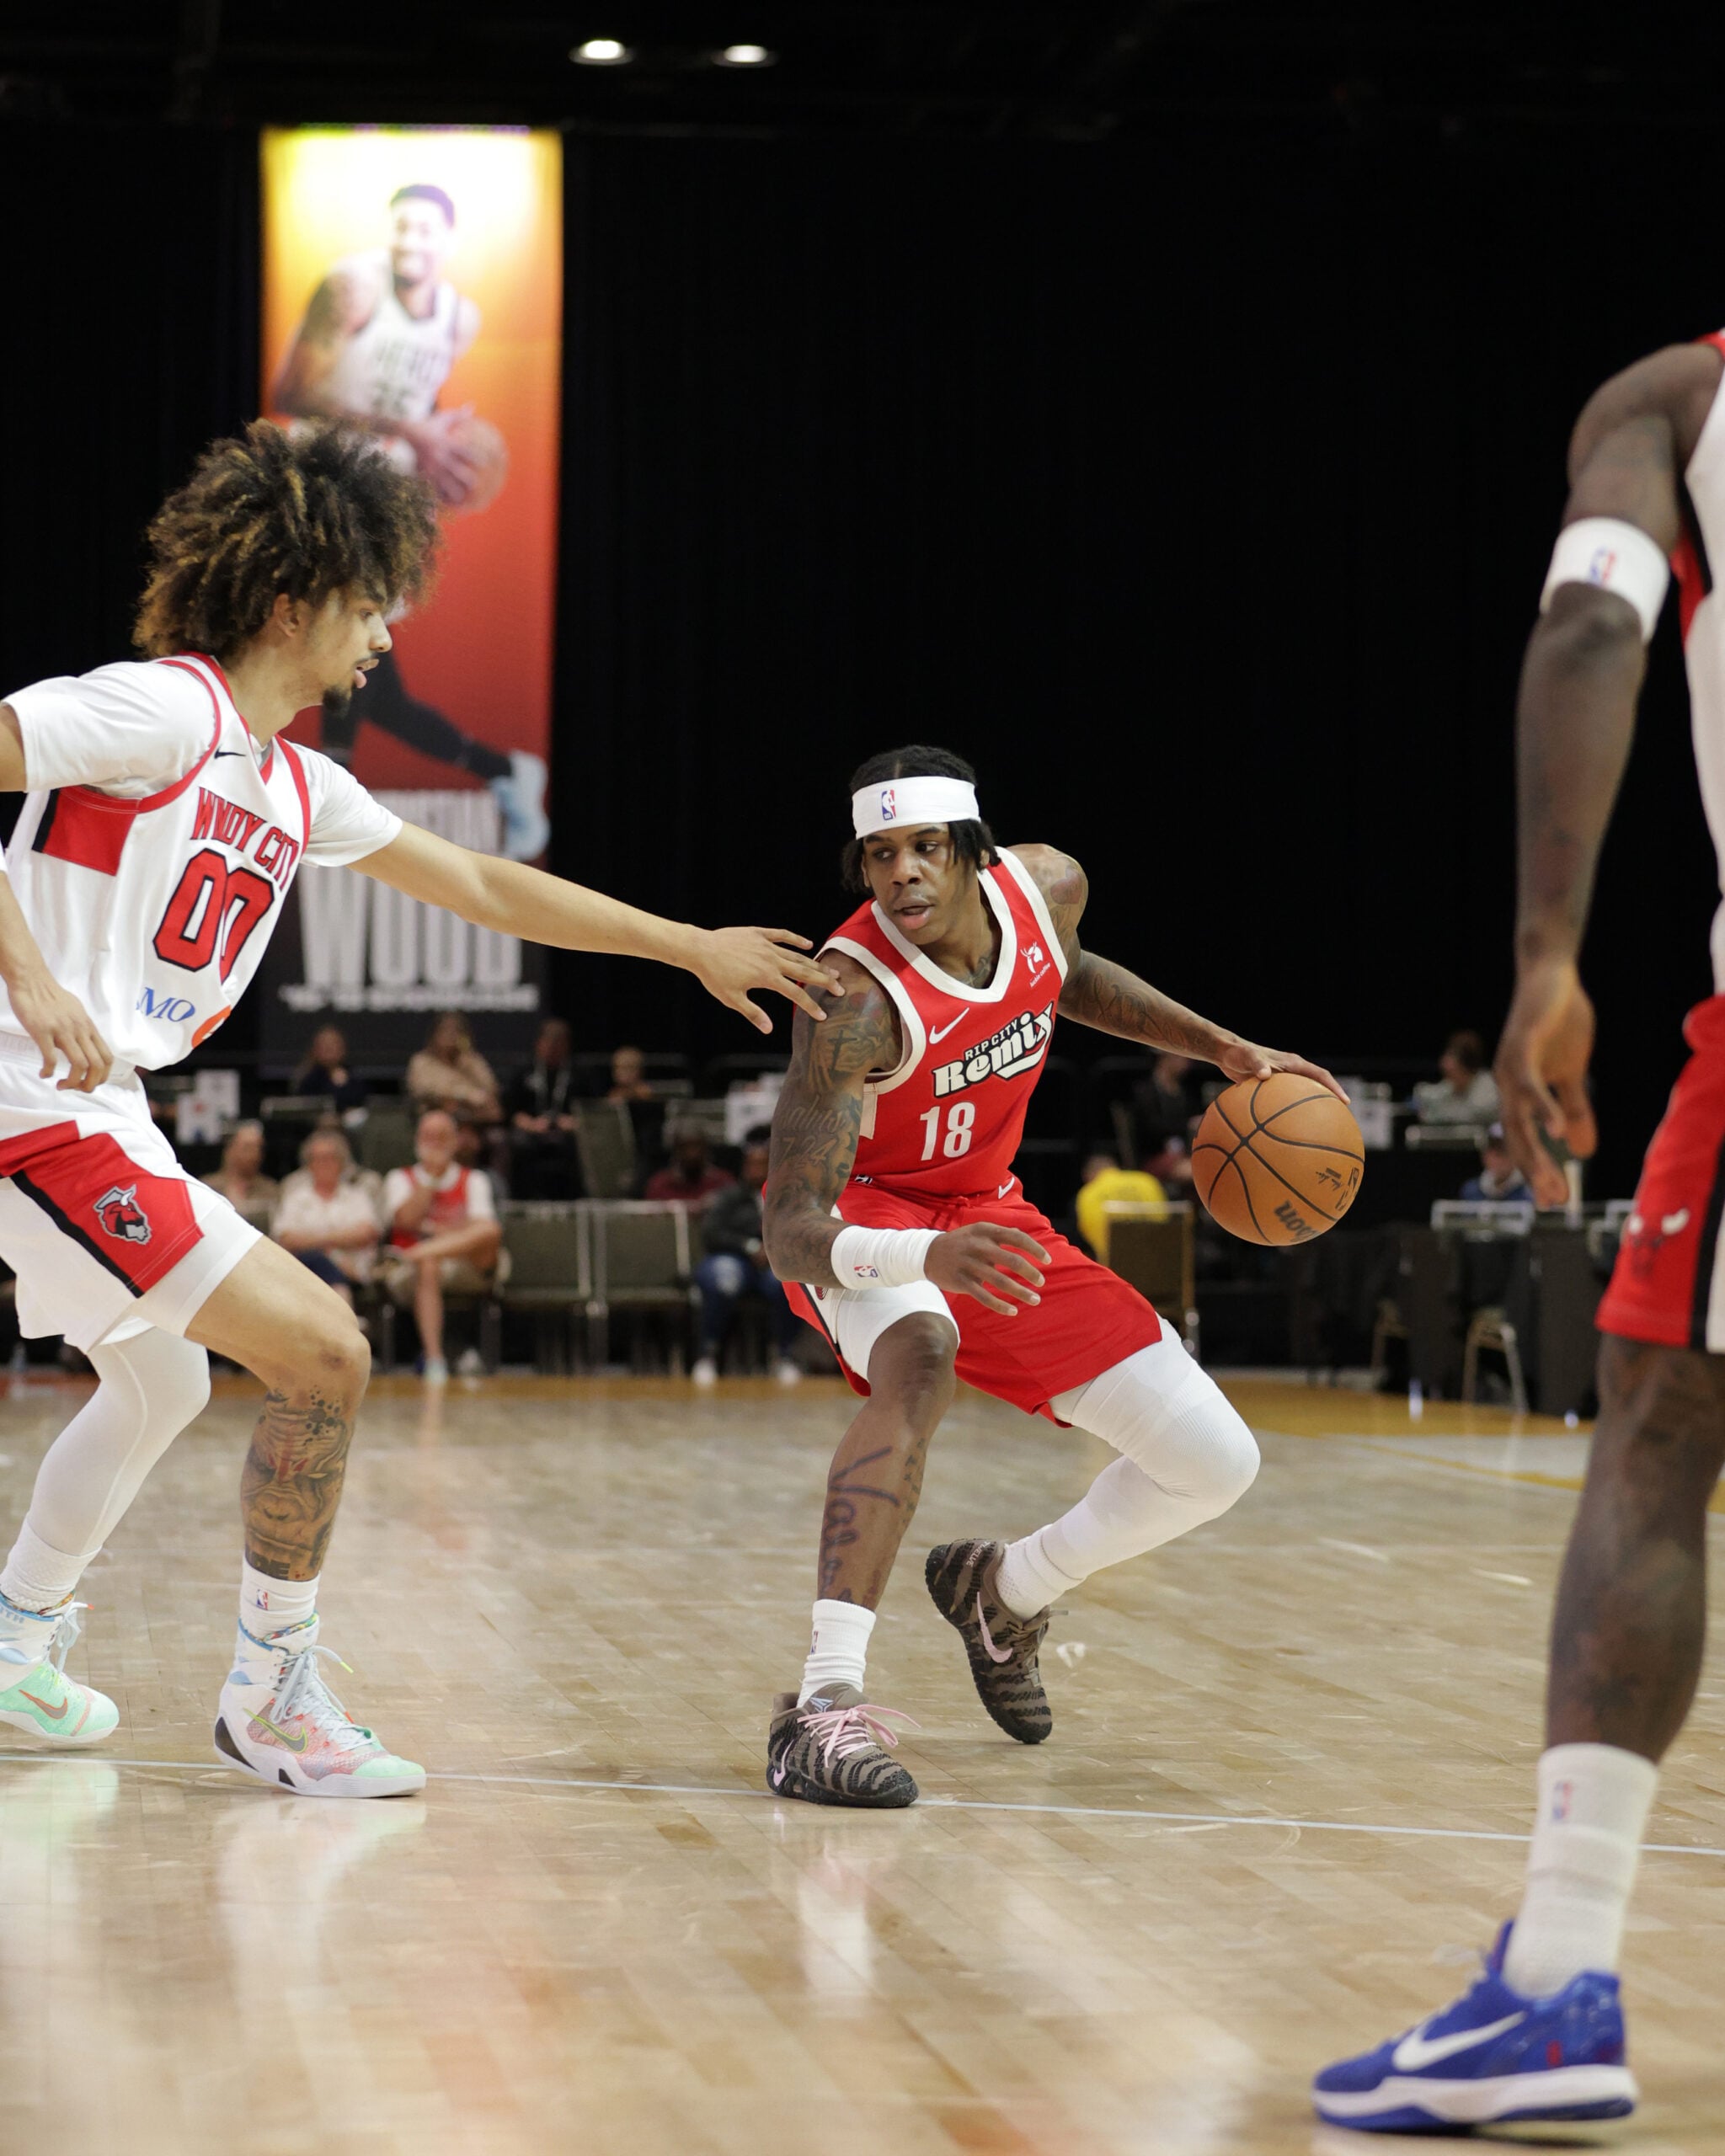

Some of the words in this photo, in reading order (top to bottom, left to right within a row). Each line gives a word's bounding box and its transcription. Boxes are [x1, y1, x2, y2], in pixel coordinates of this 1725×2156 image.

[152, 846, 276, 986] 00
[136, 986, 196, 1023] MO
[932, 1001, 1053, 1098] Remix
[964, 1039, 990, 1061] RIP
[991, 1017, 1018, 1046] CITY
[919, 1101, 976, 1162] 18
